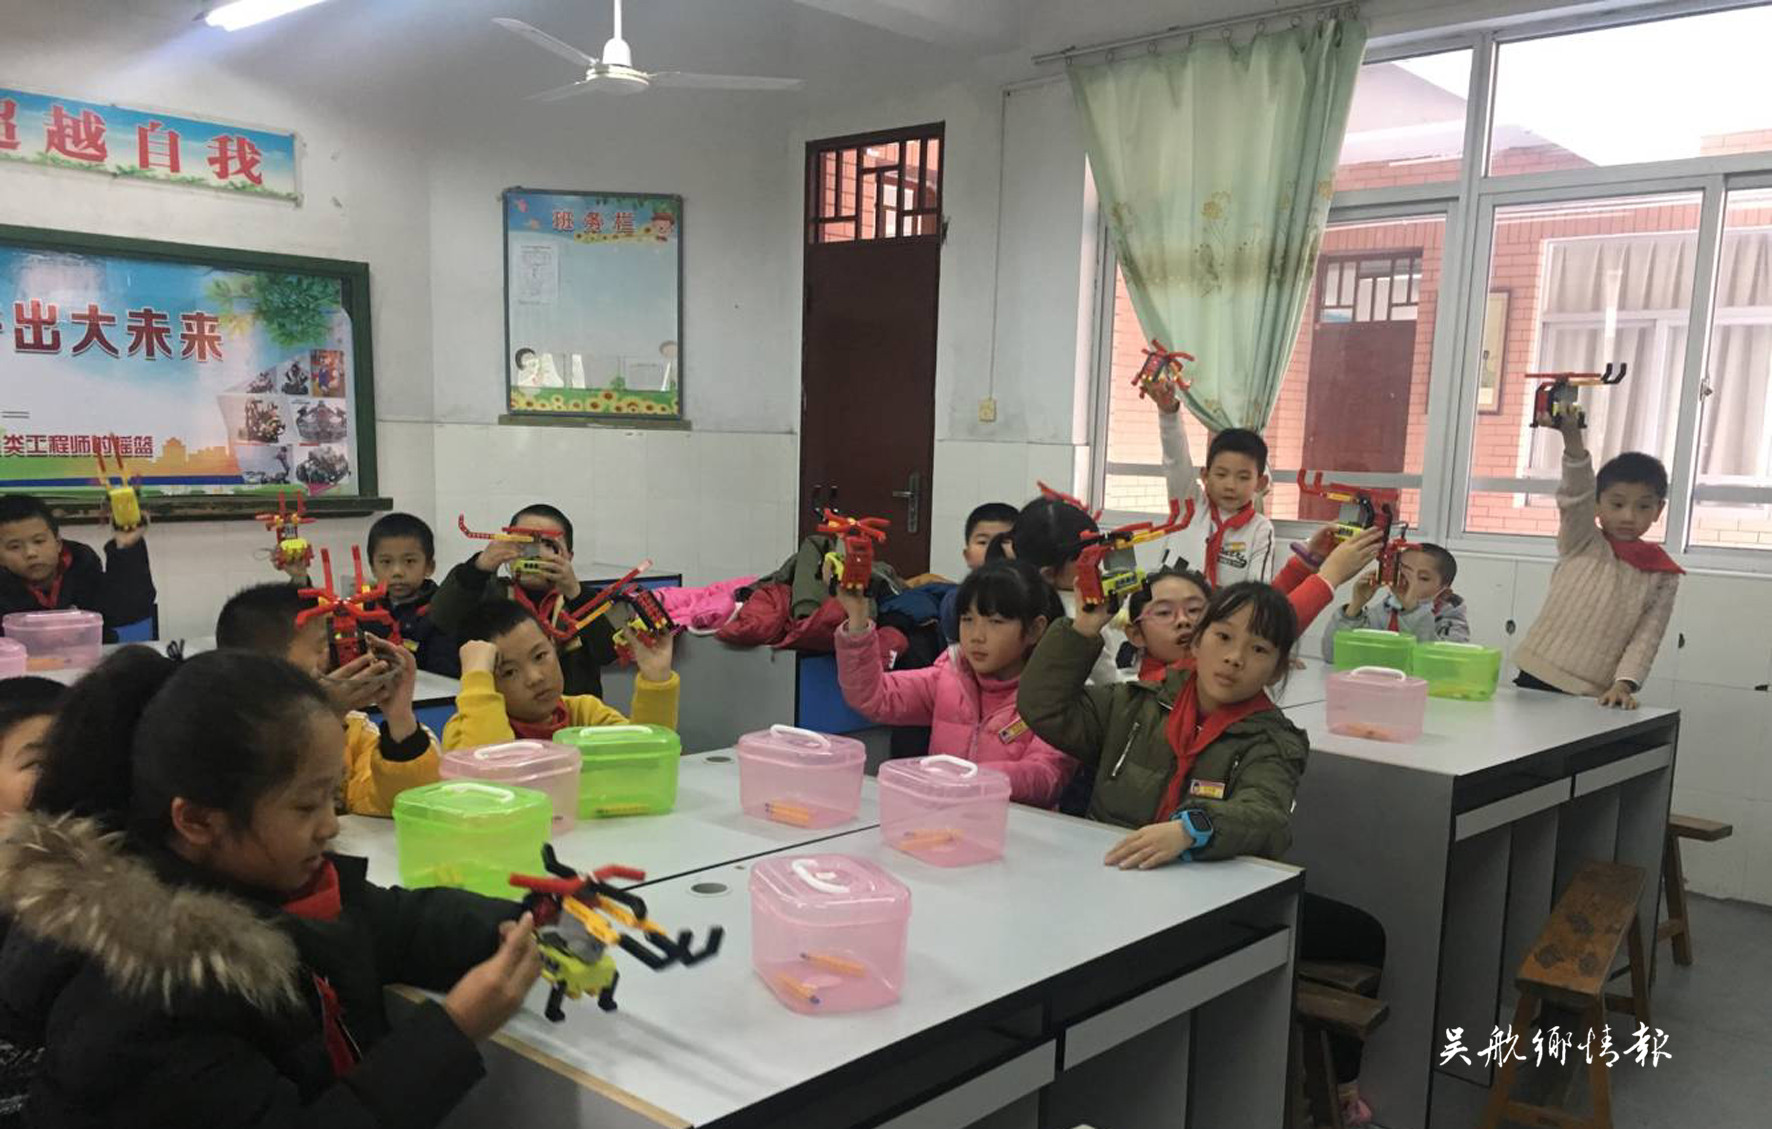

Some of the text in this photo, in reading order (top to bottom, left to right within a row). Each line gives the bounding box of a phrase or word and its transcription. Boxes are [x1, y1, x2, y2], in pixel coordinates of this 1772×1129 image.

[552, 211, 634, 234] 班务栏
[0, 299, 223, 361] 出大未来
[0, 434, 153, 456] 类工程师的摇篮
